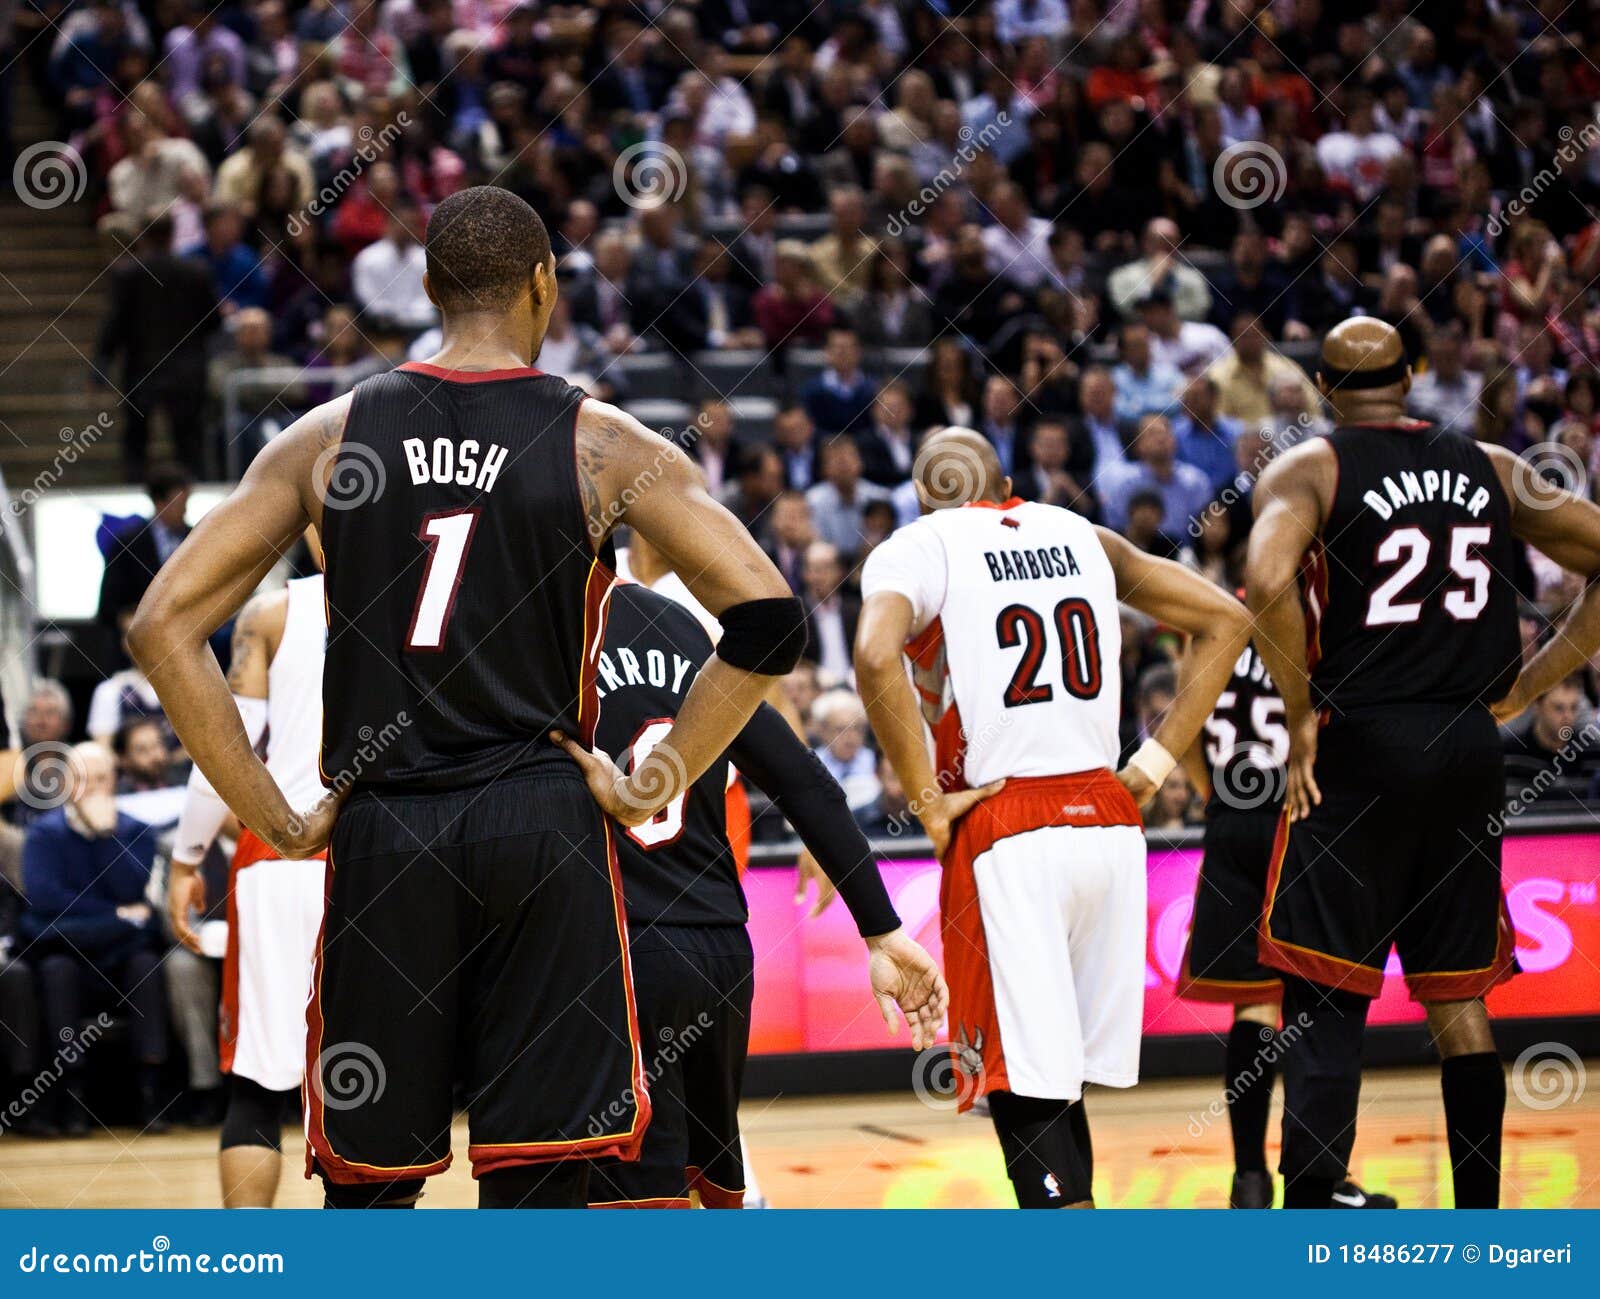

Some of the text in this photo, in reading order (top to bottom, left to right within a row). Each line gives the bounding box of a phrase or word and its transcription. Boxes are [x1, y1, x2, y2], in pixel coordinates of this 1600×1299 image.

[403, 437, 509, 493] BOSH
[1363, 469, 1490, 521] DAMPIER
[403, 507, 482, 652] 1
[983, 545, 1081, 582] BARBOSA
[1364, 524, 1494, 628] 25
[996, 597, 1103, 708] 20
[1204, 691, 1290, 769] 55
